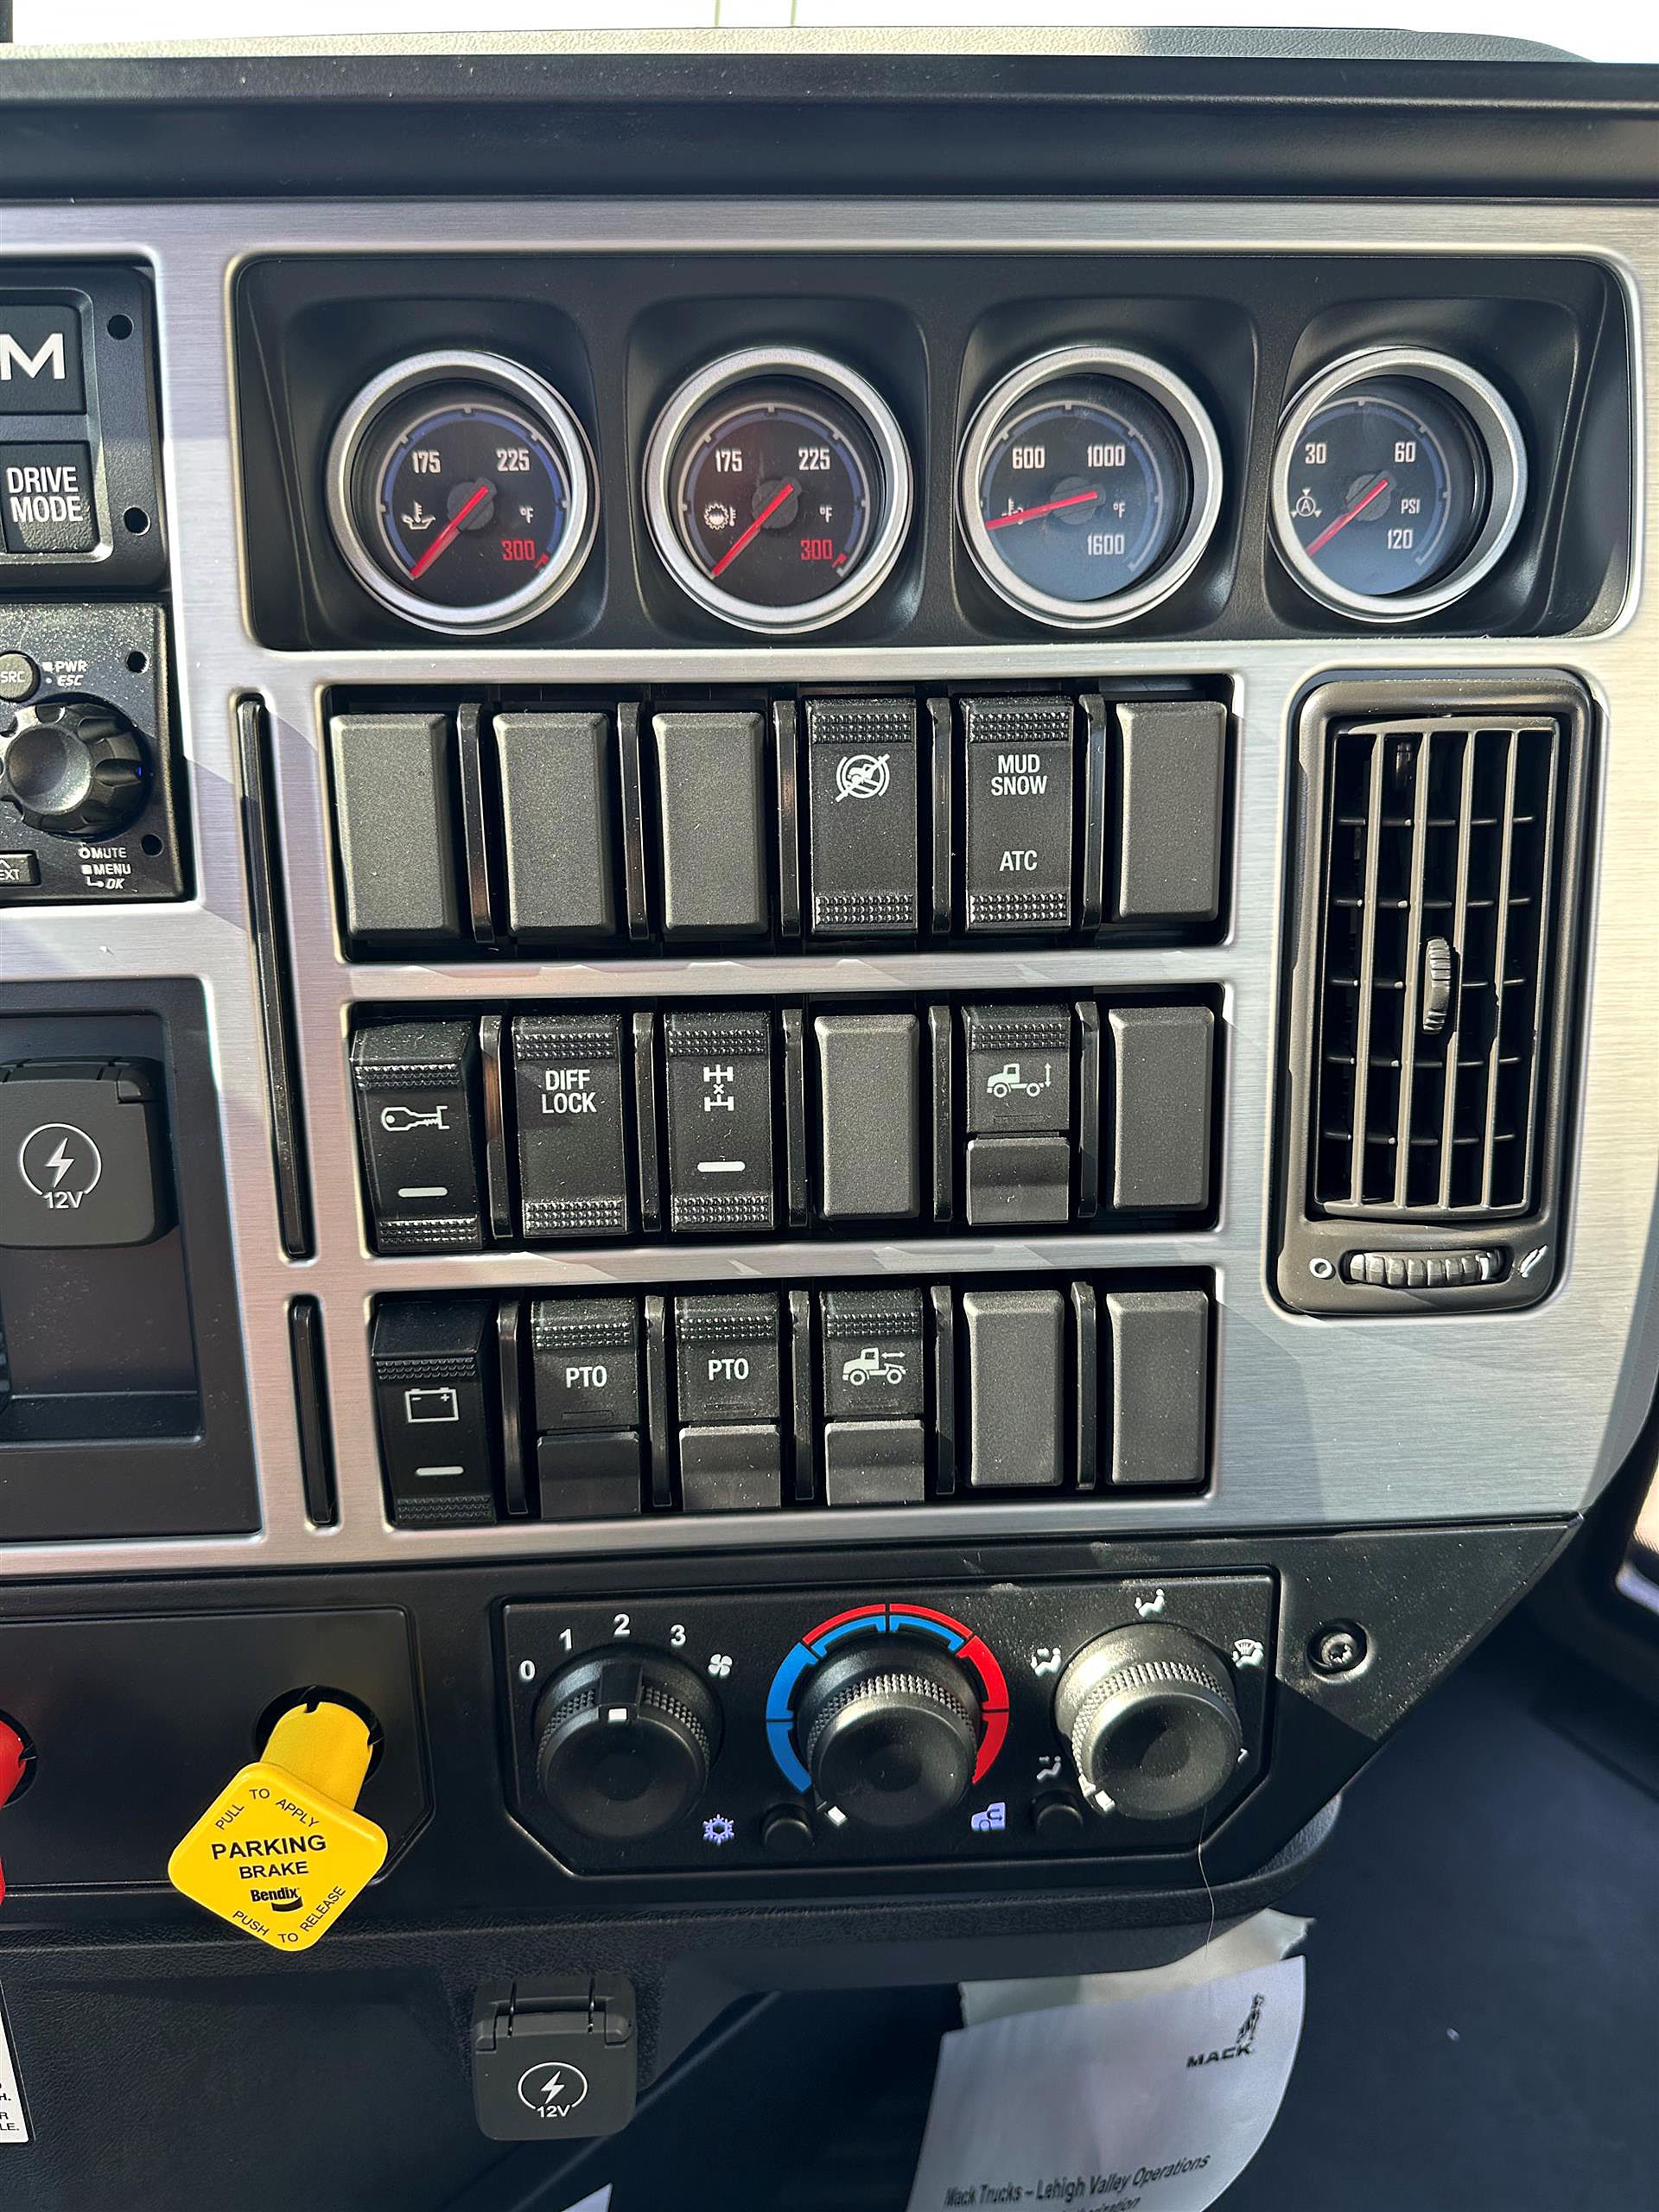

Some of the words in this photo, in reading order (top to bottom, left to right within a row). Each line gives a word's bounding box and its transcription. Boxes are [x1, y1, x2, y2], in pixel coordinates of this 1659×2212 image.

[0, 334, 66, 380] M
[412, 449, 441, 474] 175
[496, 448, 530, 472] 225
[715, 449, 743, 473] 175
[798, 448, 830, 470] 225
[1012, 446, 1046, 469] 600
[1087, 445, 1125, 467] 1000
[1305, 442, 1326, 464] 30
[1395, 442, 1416, 462] 60
[6, 466, 79, 493] DRIVE
[10, 495, 84, 523] MODE
[1401, 499, 1420, 514] PSI
[501, 539, 535, 561] 300
[800, 539, 833, 560] 300
[1087, 533, 1124, 556] 1600
[1387, 529, 1413, 549] 120
[0, 671, 26, 683] SRC
[54, 660, 88, 672] PWR
[57, 674, 84, 686] ESC
[997, 753, 1040, 774] MUD
[990, 775, 1047, 796] SNOW
[91, 847, 127, 859] MUTE
[999, 850, 1038, 872] ATC
[92, 863, 131, 875] MENU
[105, 878, 125, 889] OK
[545, 1069, 591, 1091] DIFF
[541, 1091, 597, 1114] LOCK
[43, 1191, 84, 1209] 12V
[566, 1365, 607, 1389] PTO
[708, 1357, 749, 1381] PTO
[613, 1613, 631, 1637] 2
[671, 1624, 687, 1647] 3
[559, 1629, 572, 1650] 1
[519, 1660, 536, 1681] 0
[215, 1803, 245, 1831] PULL
[249, 1788, 270, 1800] TO
[276, 1799, 319, 1827] APPLY
[211, 1834, 327, 1859] PARKING
[238, 1861, 308, 1879] BRAKE
[251, 1886, 299, 1902] Bendix
[232, 1910, 270, 1936] PUSH
[278, 1932, 299, 1943] TO
[300, 1885, 346, 1931] RELEASE
[1185, 2042, 1252, 2069] MACK
[537, 2104, 570, 2118] 12V
[943, 2186, 977, 2208] Mack
[979, 2183, 1022, 2205] Trucks
[1035, 2177, 1086, 2204] Lehigh
[1089, 2173, 1130, 2195] Valley
[1131, 2152, 1212, 2189] Operations
